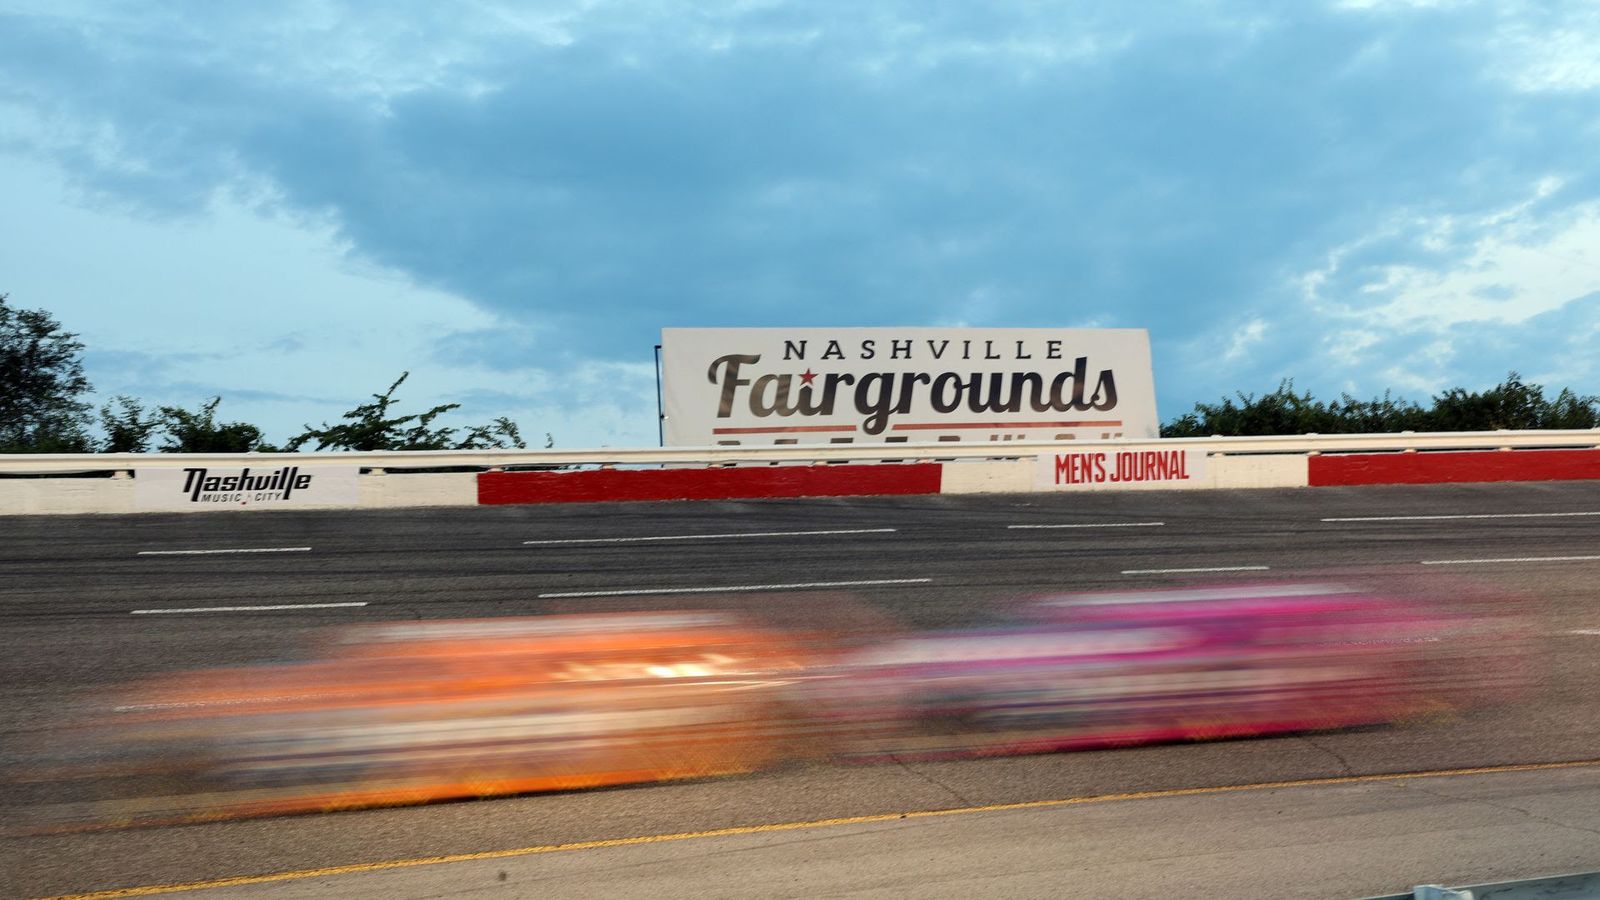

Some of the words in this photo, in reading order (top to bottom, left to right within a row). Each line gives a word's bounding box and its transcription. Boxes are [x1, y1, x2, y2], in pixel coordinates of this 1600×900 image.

[783, 339, 1063, 360] NASHVILLE
[707, 353, 1119, 435] Fairgrounds
[182, 466, 312, 502] Nashville
[1055, 452, 1106, 485] MEN'S
[1110, 450, 1190, 483] JOURNAL
[201, 493, 241, 503] MUSIC
[254, 492, 282, 502] CITY
